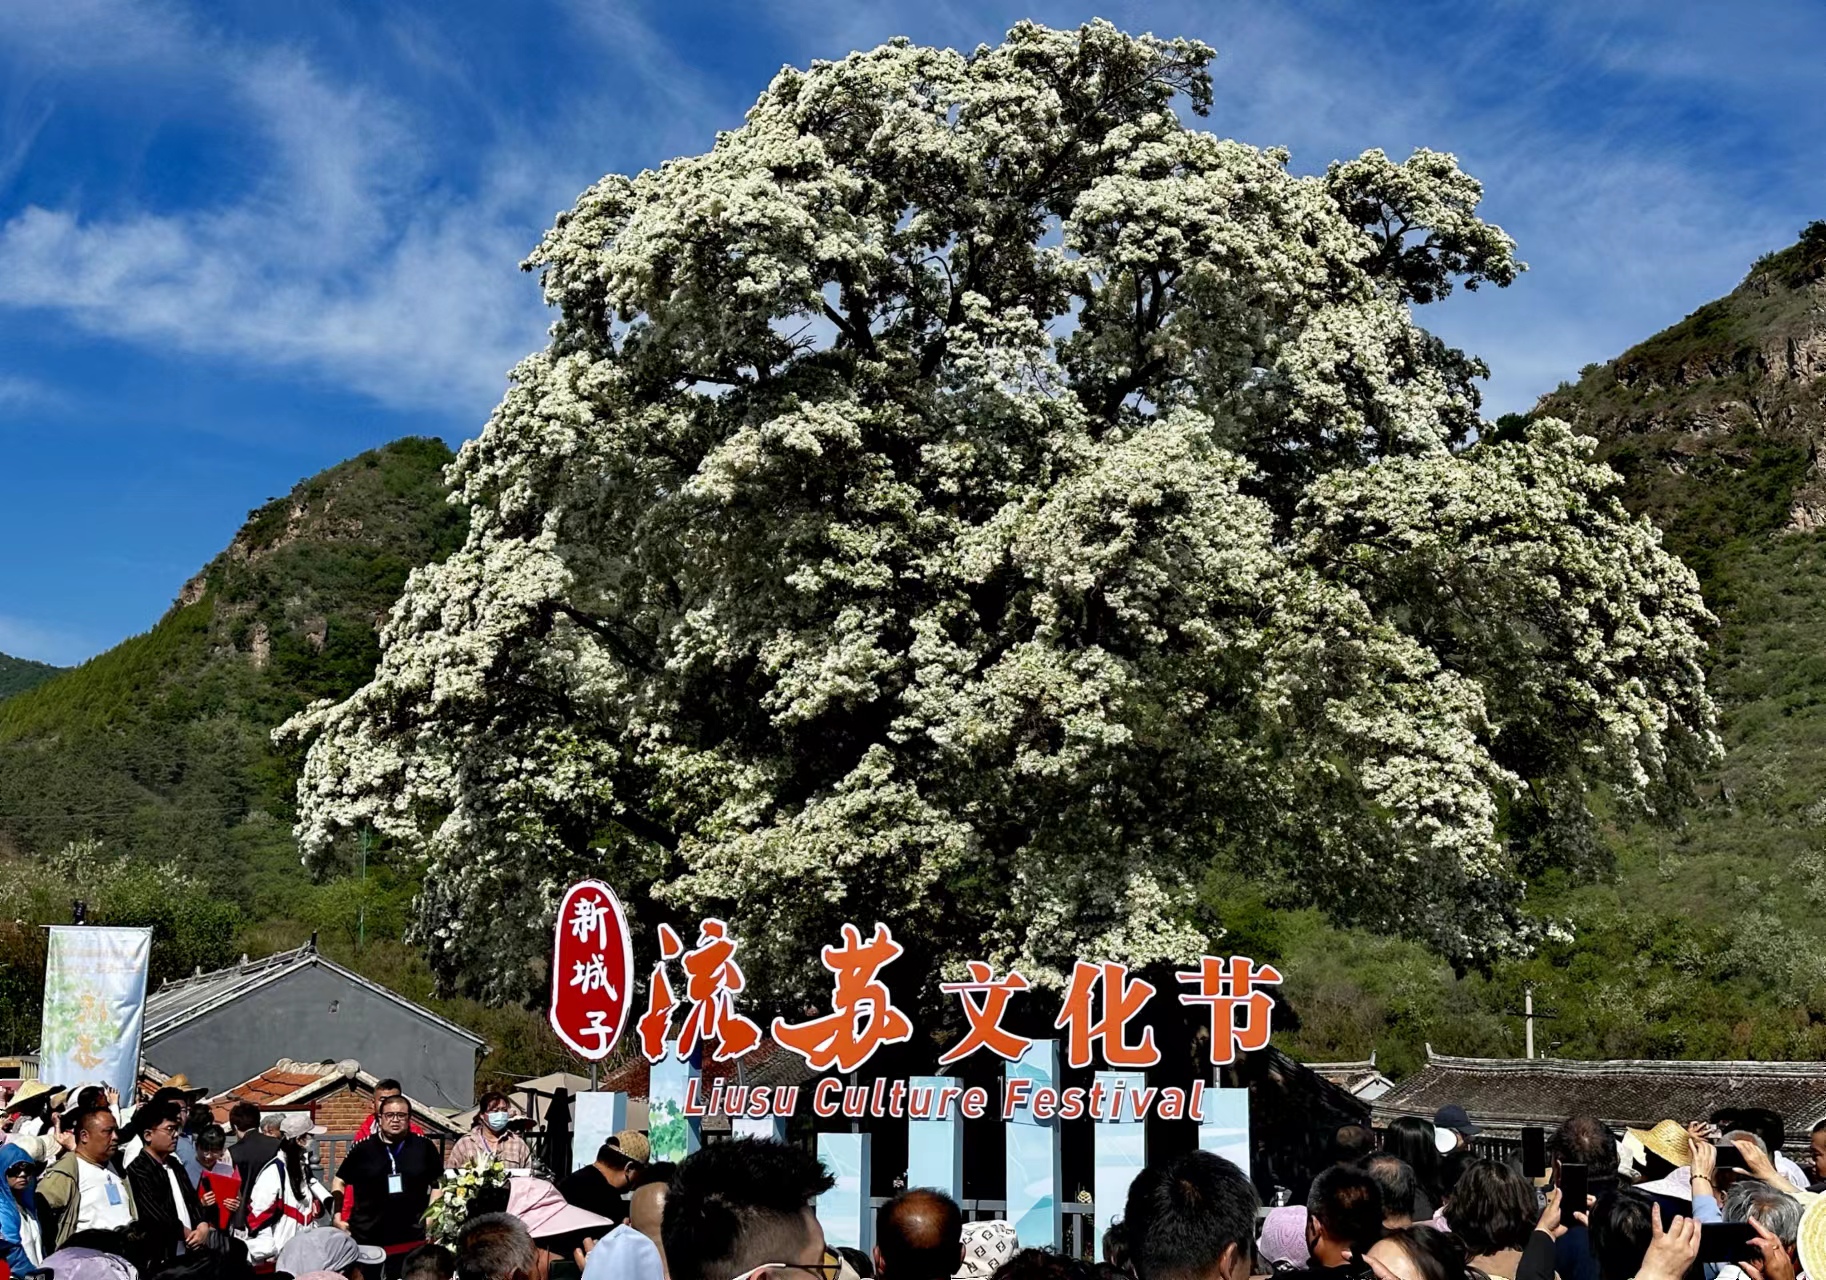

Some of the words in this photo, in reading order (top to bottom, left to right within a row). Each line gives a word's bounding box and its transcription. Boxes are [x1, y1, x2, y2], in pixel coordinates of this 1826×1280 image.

[569, 894, 618, 1050] 新城子
[637, 917, 1283, 1073] 流苏文化节
[683, 1077, 799, 1118] Liusu
[814, 1077, 988, 1119] Culture
[1002, 1078, 1205, 1120] Festival
